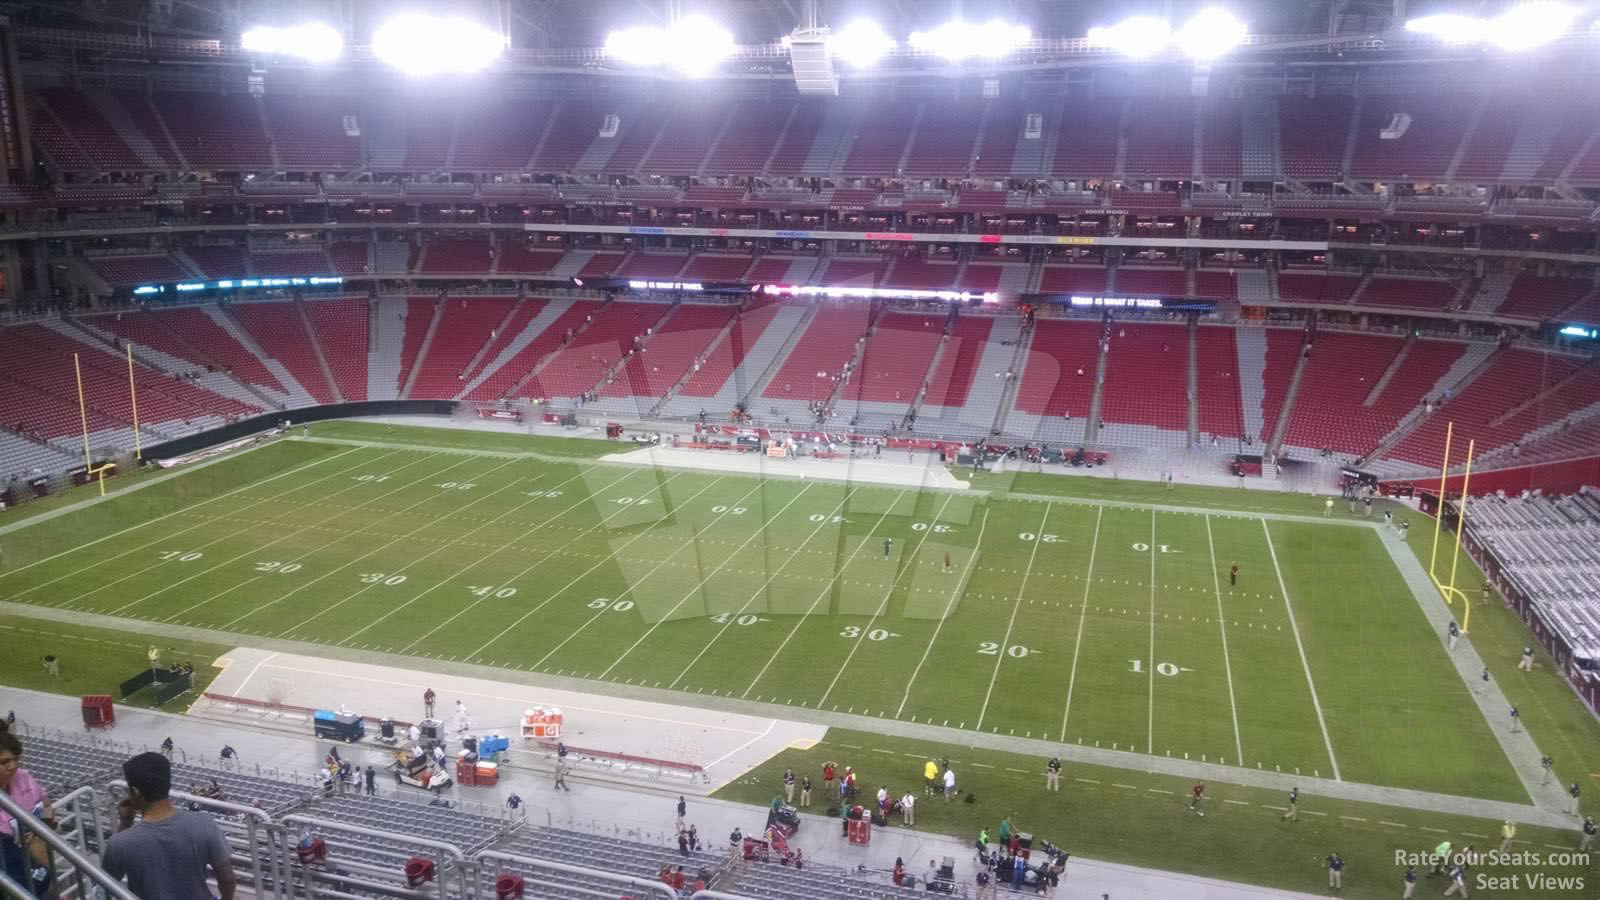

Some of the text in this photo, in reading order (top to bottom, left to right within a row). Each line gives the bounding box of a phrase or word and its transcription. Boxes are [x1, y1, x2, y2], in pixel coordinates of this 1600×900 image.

[587, 598, 635, 611] 50
[709, 612, 758, 627] 40
[840, 626, 890, 642] 30
[976, 642, 1029, 658] 20
[1127, 659, 1179, 676] 10
